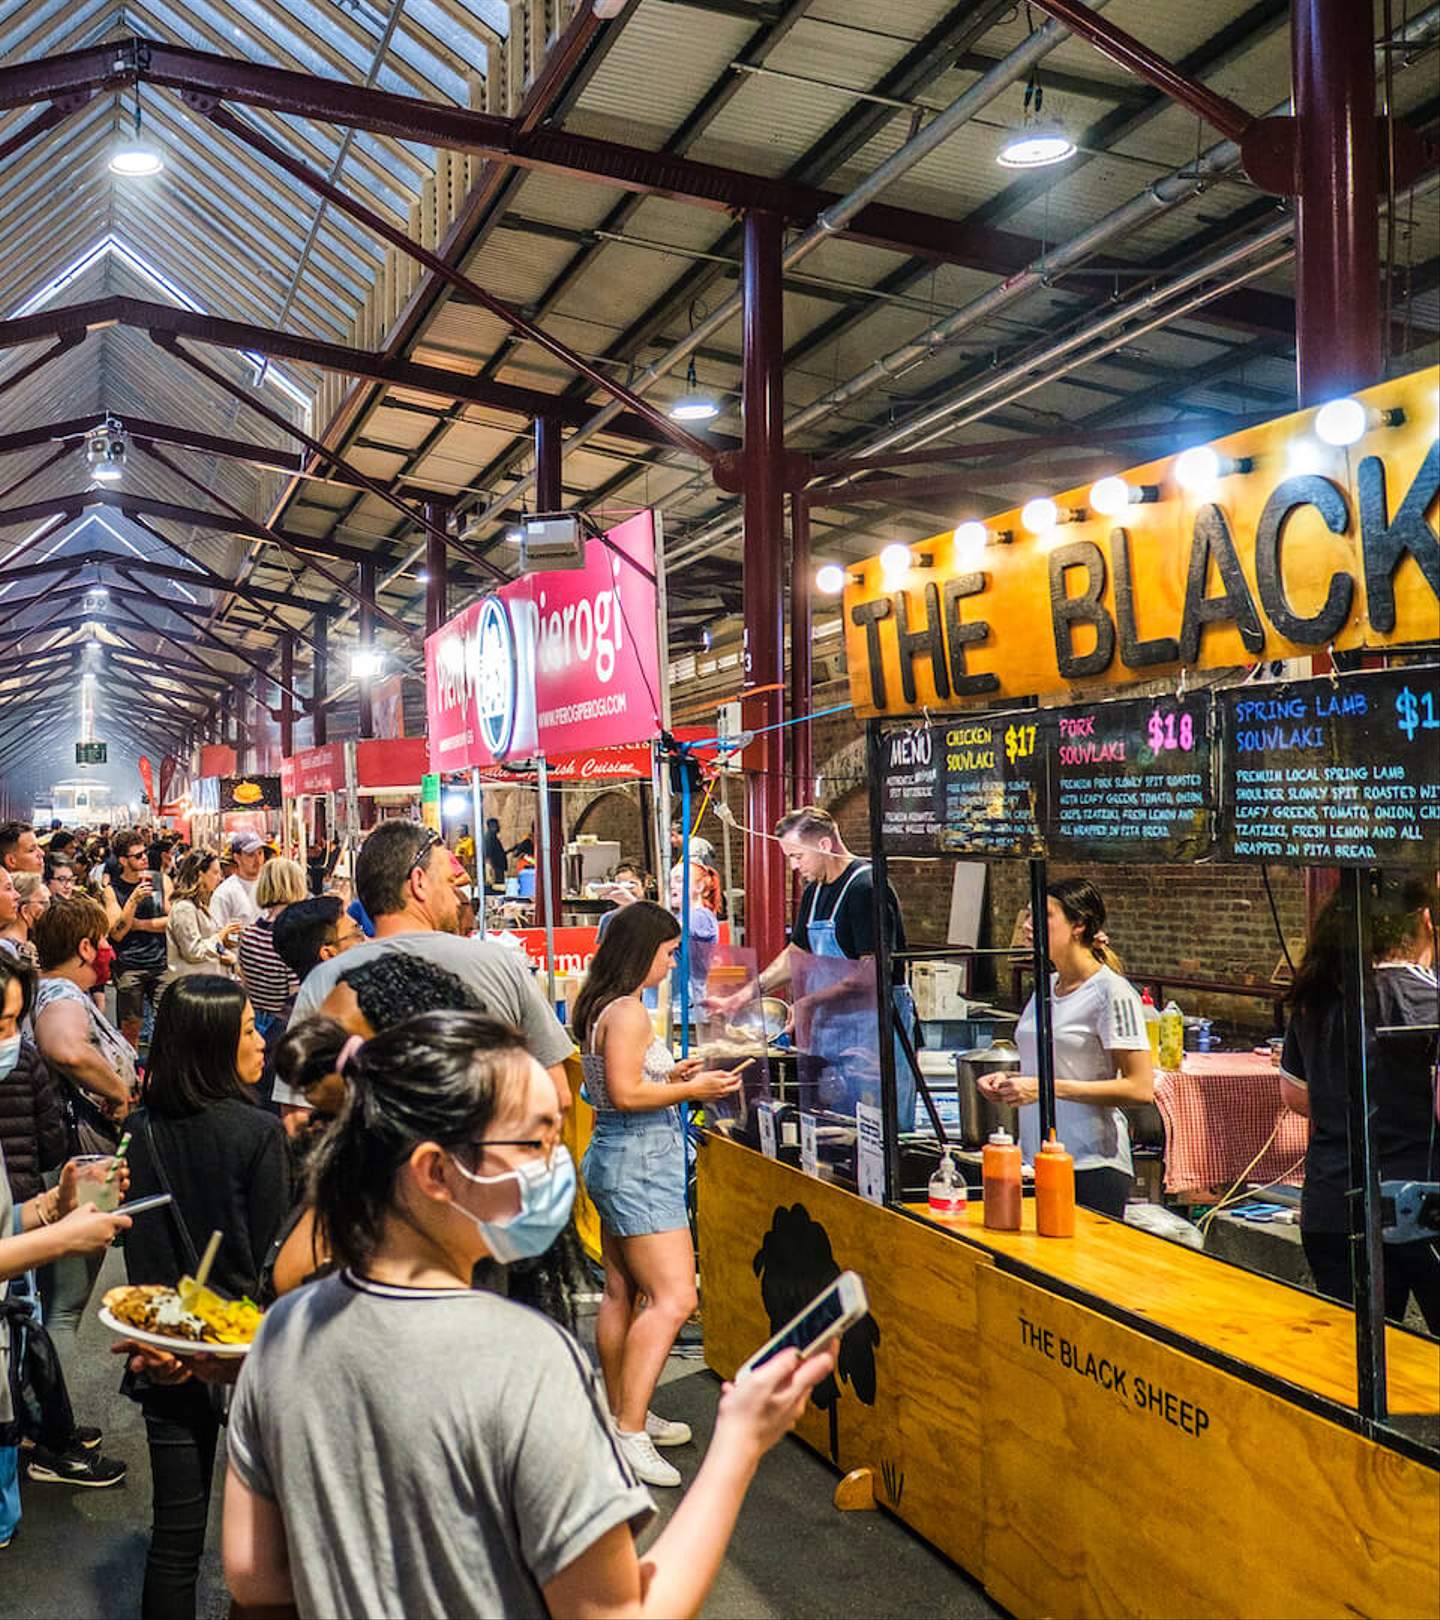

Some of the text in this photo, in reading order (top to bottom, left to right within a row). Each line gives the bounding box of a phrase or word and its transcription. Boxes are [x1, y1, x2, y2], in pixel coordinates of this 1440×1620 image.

[851, 436, 1440, 710] THE BLACK
[526, 556, 623, 683] Pierogi
[1235, 694, 1369, 723] SPRING LAMB
[946, 727, 992, 747] CHICKEN
[1059, 716, 1095, 738] PORK
[1147, 710, 1194, 756] $18
[890, 728, 932, 769] MENU
[1004, 724, 1037, 765] $17
[1059, 740, 1127, 765] SOUVLAKI
[1236, 727, 1325, 753] SOUVLAKI
[946, 750, 995, 772] SOUVLAKI
[1286, 768, 1320, 781] LOCAL
[1324, 766, 1368, 781] SPRING
[1373, 765, 1405, 780] LAMB
[1287, 786, 1328, 801] SLOWLY
[1331, 785, 1359, 800] SPIT
[1363, 785, 1416, 800] ROASTED
[1235, 804, 1270, 818] LEAFY
[1292, 825, 1326, 838] FRESH
[1330, 825, 1368, 839] LEMON
[1371, 825, 1397, 839] AND
[1234, 841, 1282, 856] WRAPPED
[1285, 843, 1299, 857] IN
[1303, 843, 1331, 857] PITA
[1018, 1316, 1210, 1438] THE BLACK SHEEP
